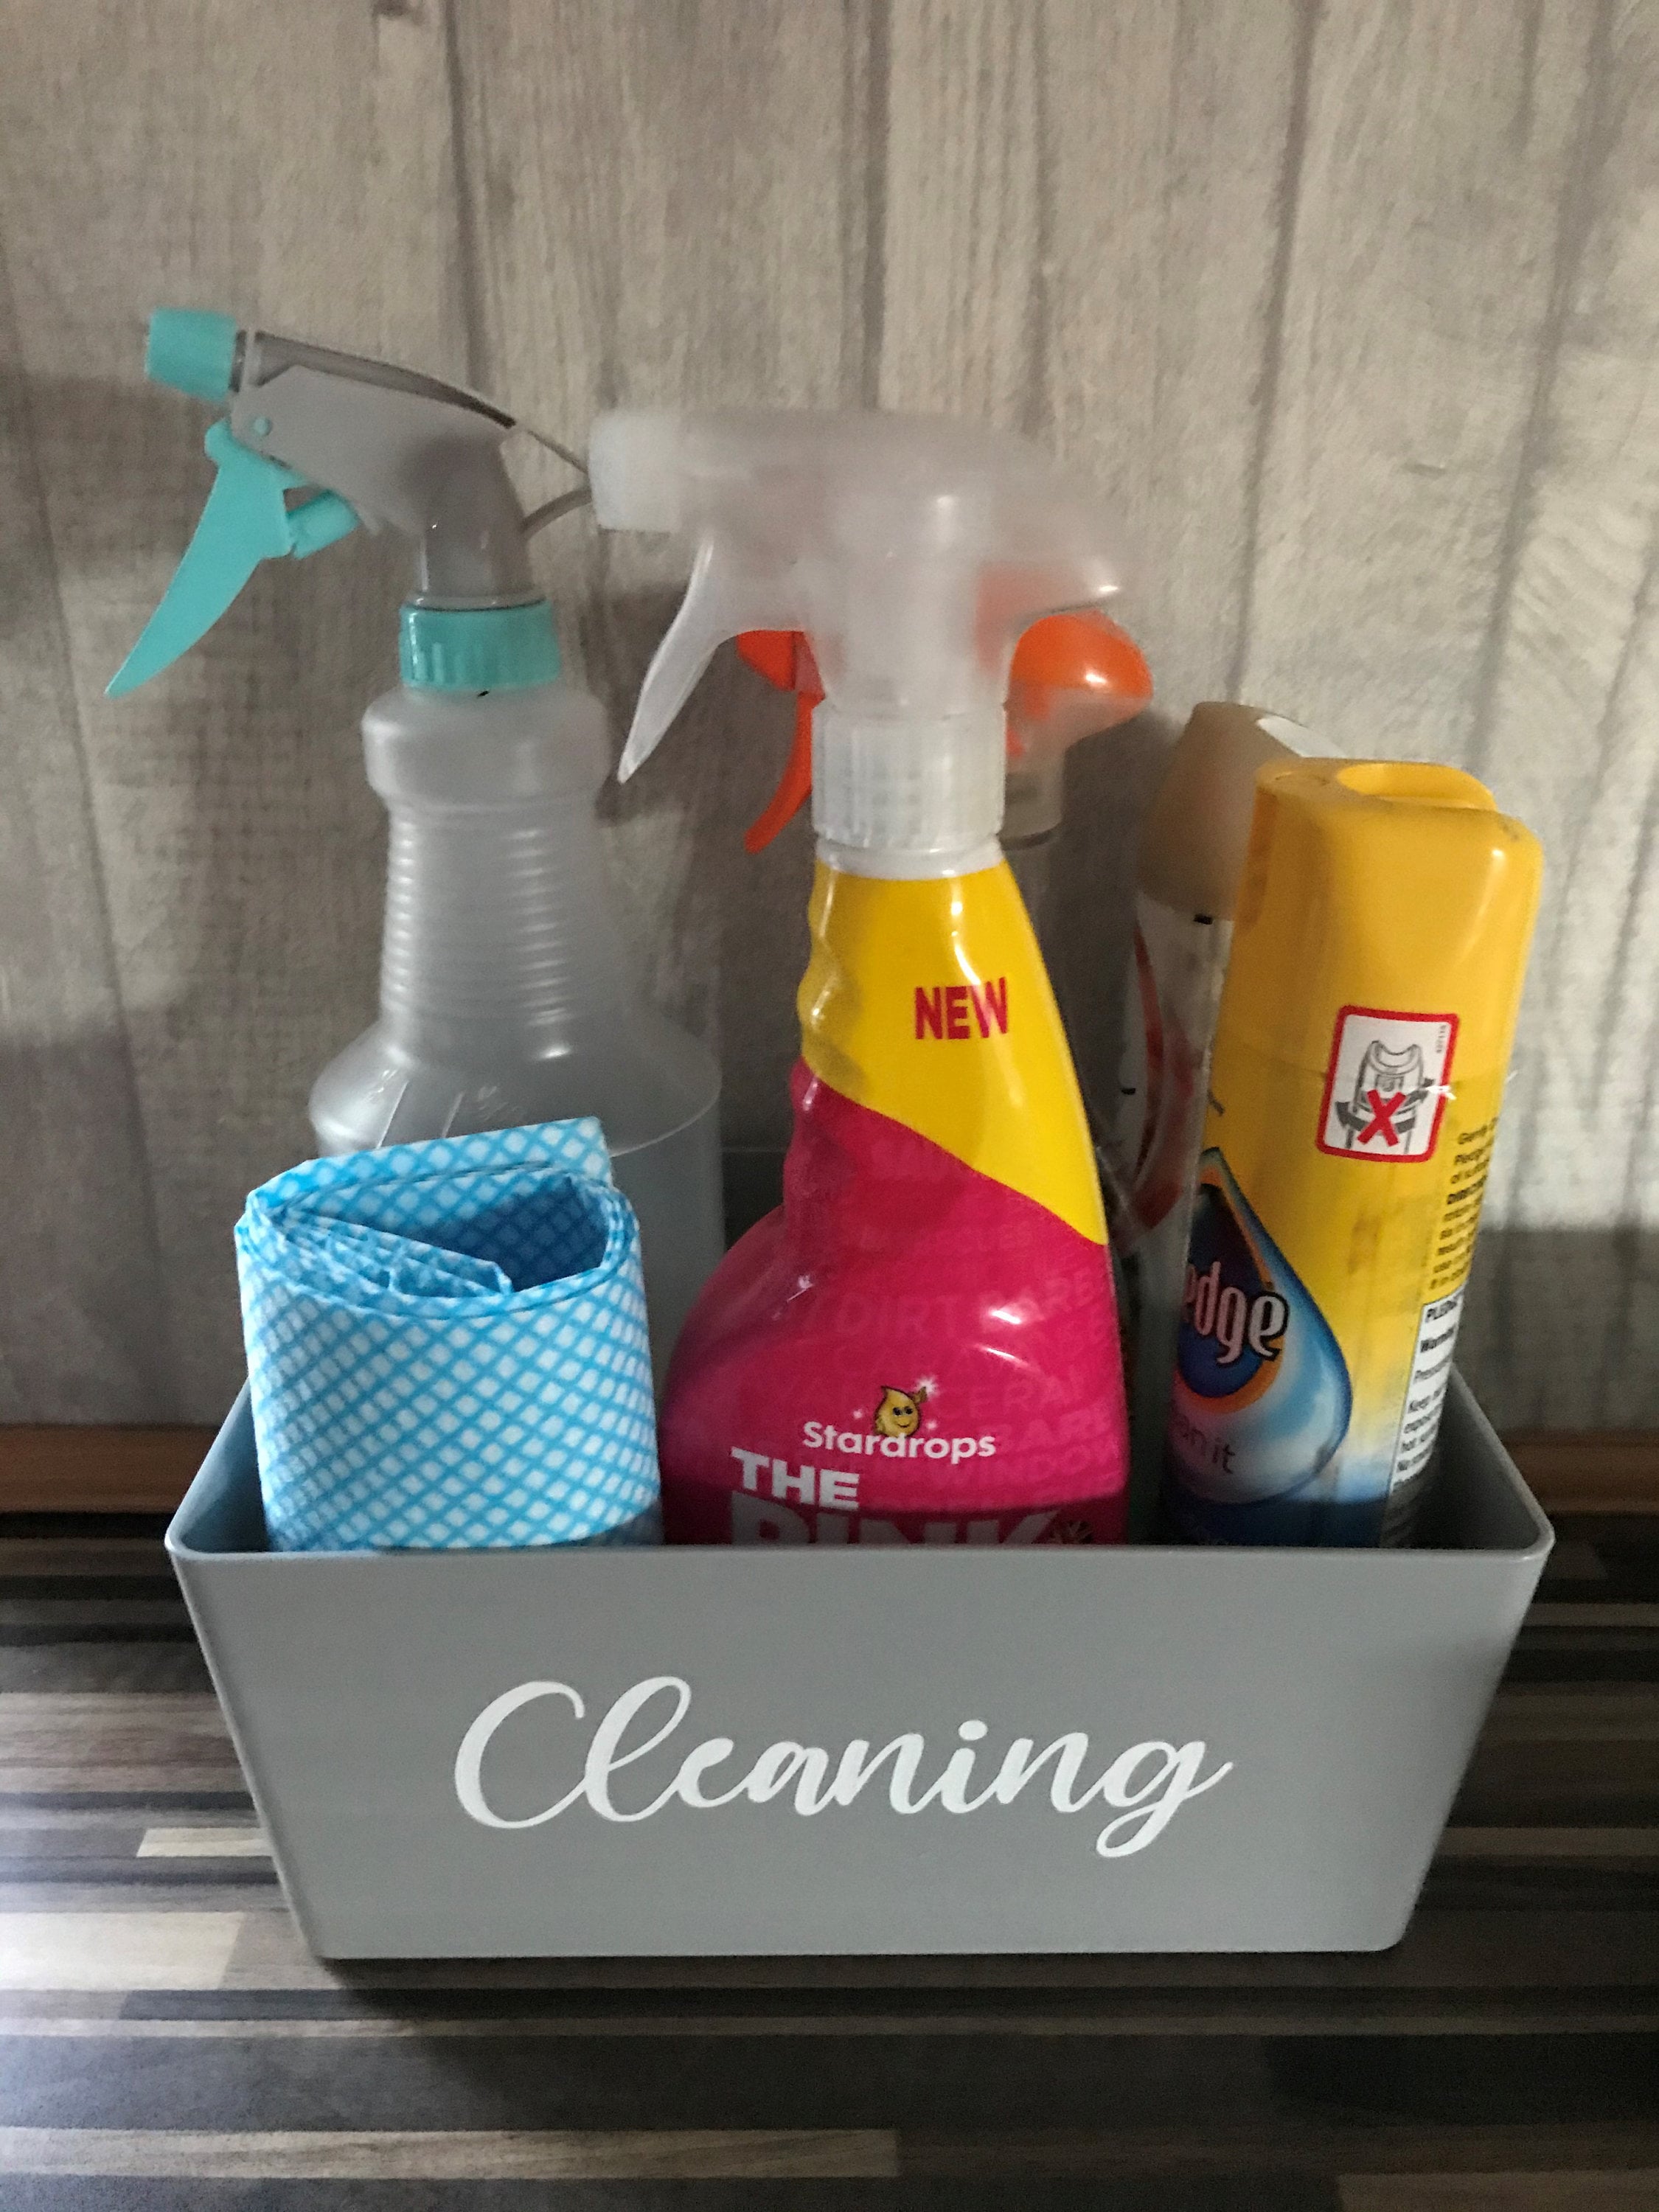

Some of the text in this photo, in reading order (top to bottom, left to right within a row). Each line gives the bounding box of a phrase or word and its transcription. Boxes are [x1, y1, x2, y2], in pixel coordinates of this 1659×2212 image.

[915, 977, 1008, 1040] NEW
[803, 1421, 996, 1464] Stardrops
[731, 1446, 860, 1510] THE
[454, 1675, 1234, 1858] Cleaning
